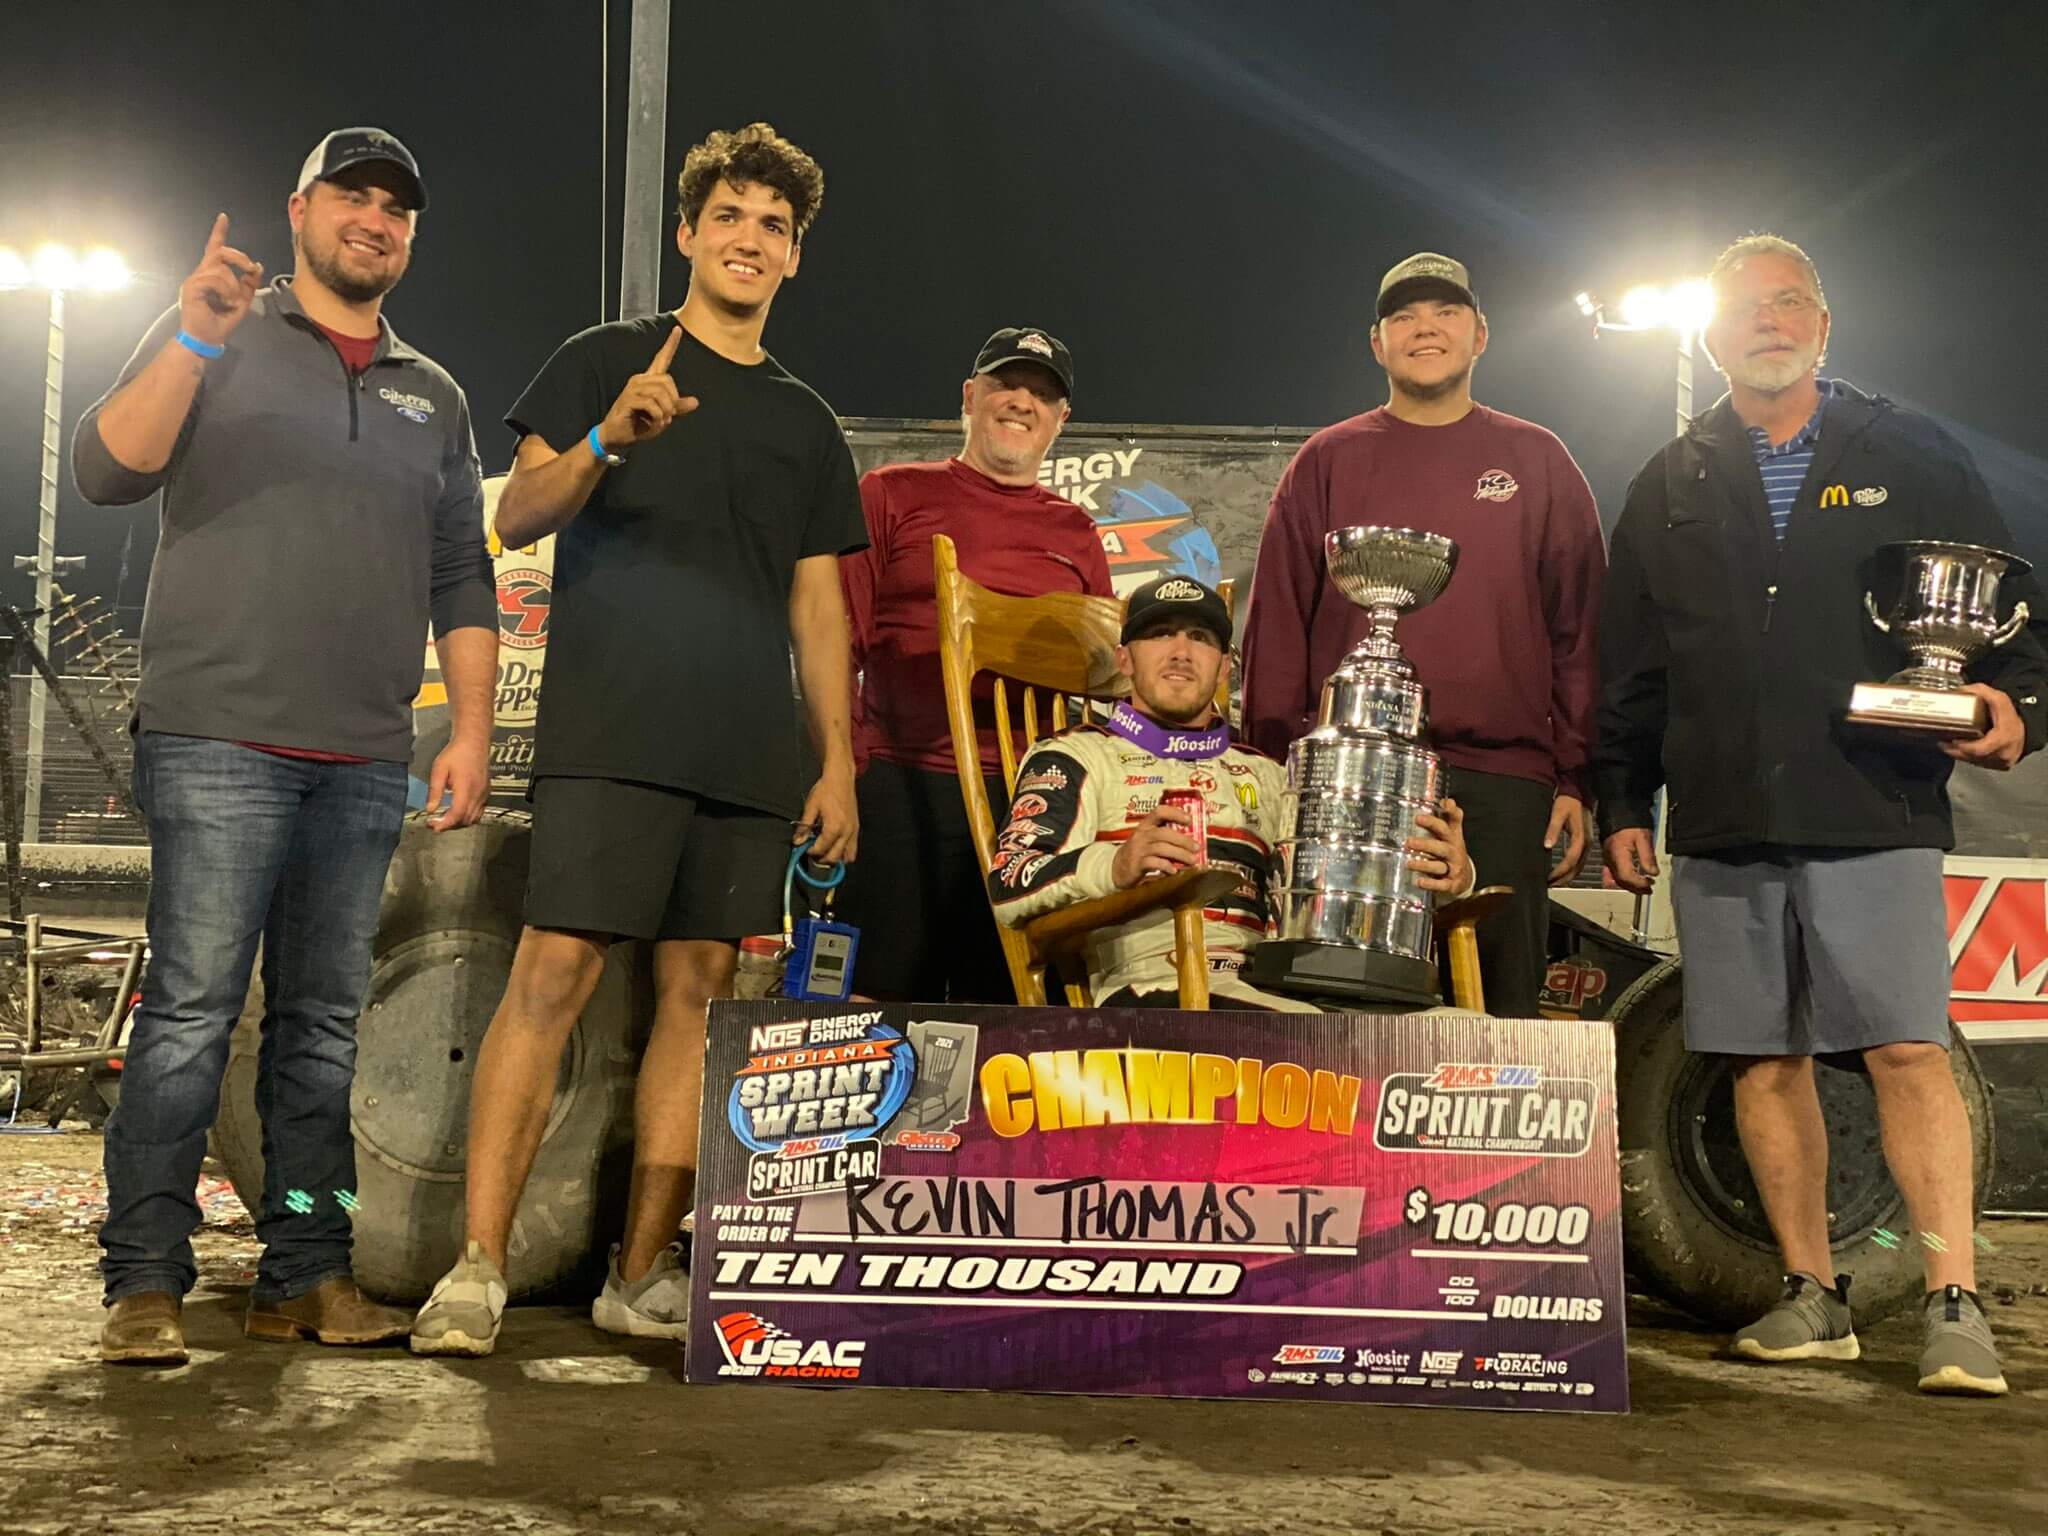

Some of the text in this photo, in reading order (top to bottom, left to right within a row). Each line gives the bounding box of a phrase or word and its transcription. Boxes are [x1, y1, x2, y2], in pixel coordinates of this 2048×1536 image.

[1037, 448, 1143, 487] ERGY
[502, 661, 543, 687] Dr
[1163, 736, 1222, 753] Hoosier
[1124, 775, 1165, 785] AMSOIL
[810, 1011, 884, 1031] ENERGY
[751, 1021, 807, 1051] NOS
[809, 1027, 866, 1043] DRINK
[762, 1045, 875, 1067] INDIANA
[739, 1060, 891, 1107] SPRINT
[1424, 1064, 1539, 1091] AMSOIL
[980, 1048, 1362, 1138] CHAMPION
[751, 1094, 878, 1138] WEEK
[1383, 1088, 1588, 1140] SPRINT CAR
[777, 1136, 846, 1160] AMSOIL
[752, 1150, 876, 1192] SPRINT CAR
[711, 1204, 794, 1222] PAY TO THE
[846, 1175, 1340, 1256] KEVIN THOMAS Jr.
[1432, 1202, 1590, 1245] 10,000
[717, 1225, 790, 1242] ORDER OF
[715, 1252, 1242, 1296] TEN THOUSAND
[1492, 1295, 1603, 1322] DOLLARS
[739, 1339, 866, 1367] USAC
[1273, 1345, 1344, 1364] AMSOIL
[1354, 1349, 1410, 1367] Hoosier
[1421, 1350, 1463, 1370] NOS
[1484, 1357, 1568, 1374] FLORACING
[764, 1366, 861, 1378] RACING
